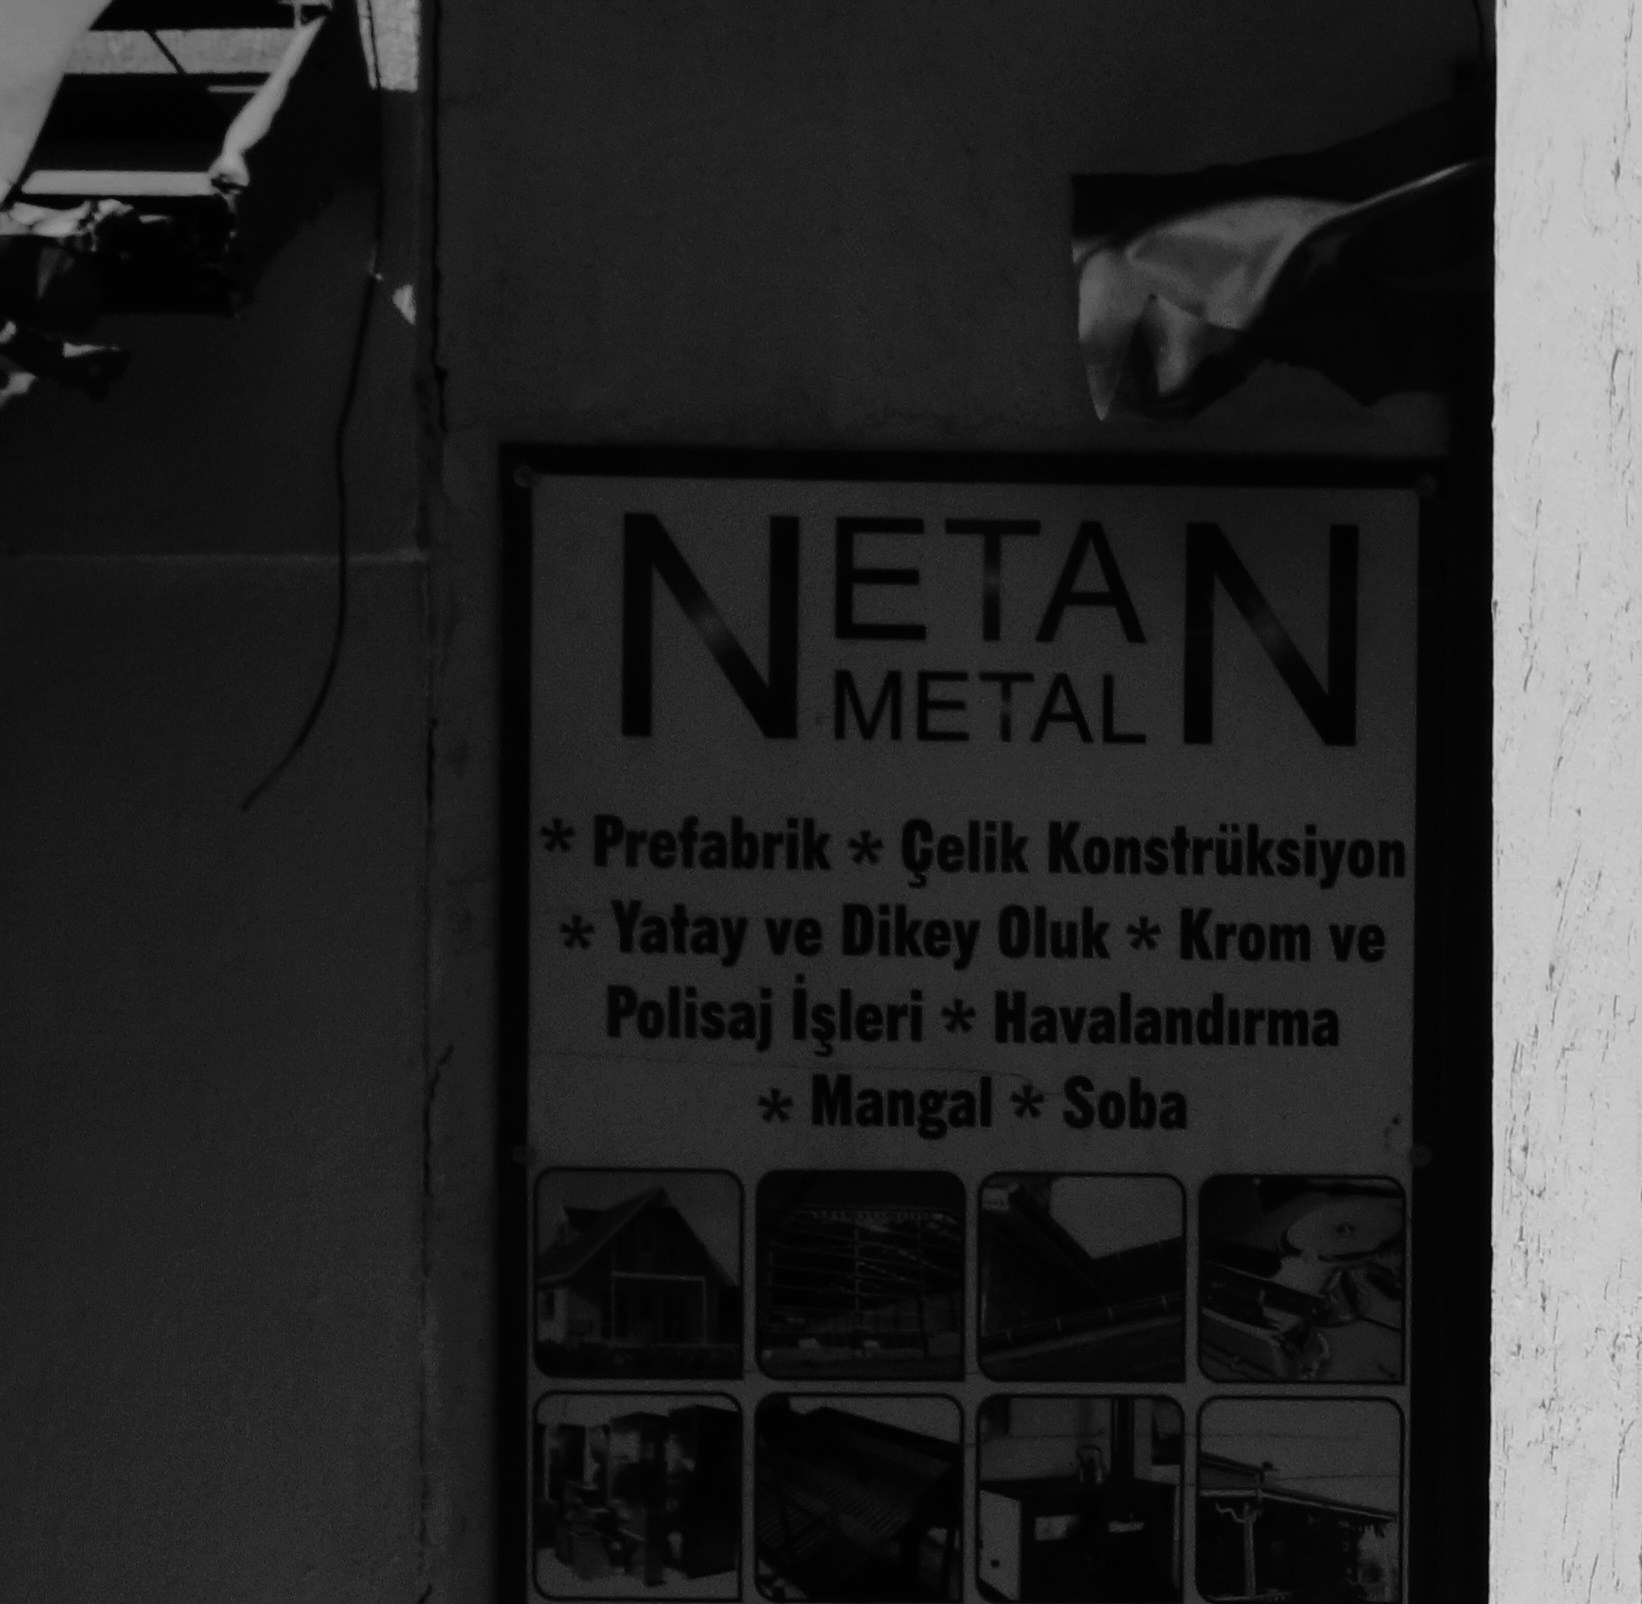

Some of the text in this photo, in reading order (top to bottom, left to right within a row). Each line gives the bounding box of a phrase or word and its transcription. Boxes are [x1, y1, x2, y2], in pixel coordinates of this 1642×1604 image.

[621, 511, 1360, 748] NETAN
[833, 669, 1147, 745] METAL
[592, 813, 1407, 890] Prefabrik Çelik Konstrüksiyon
[610, 899, 1387, 971] Yatay ve Dikey Oluk Krom ve
[606, 973, 1340, 1058] Polisaj İşleri Havalandırma
[810, 1072, 1188, 1141] Mangal Soba
